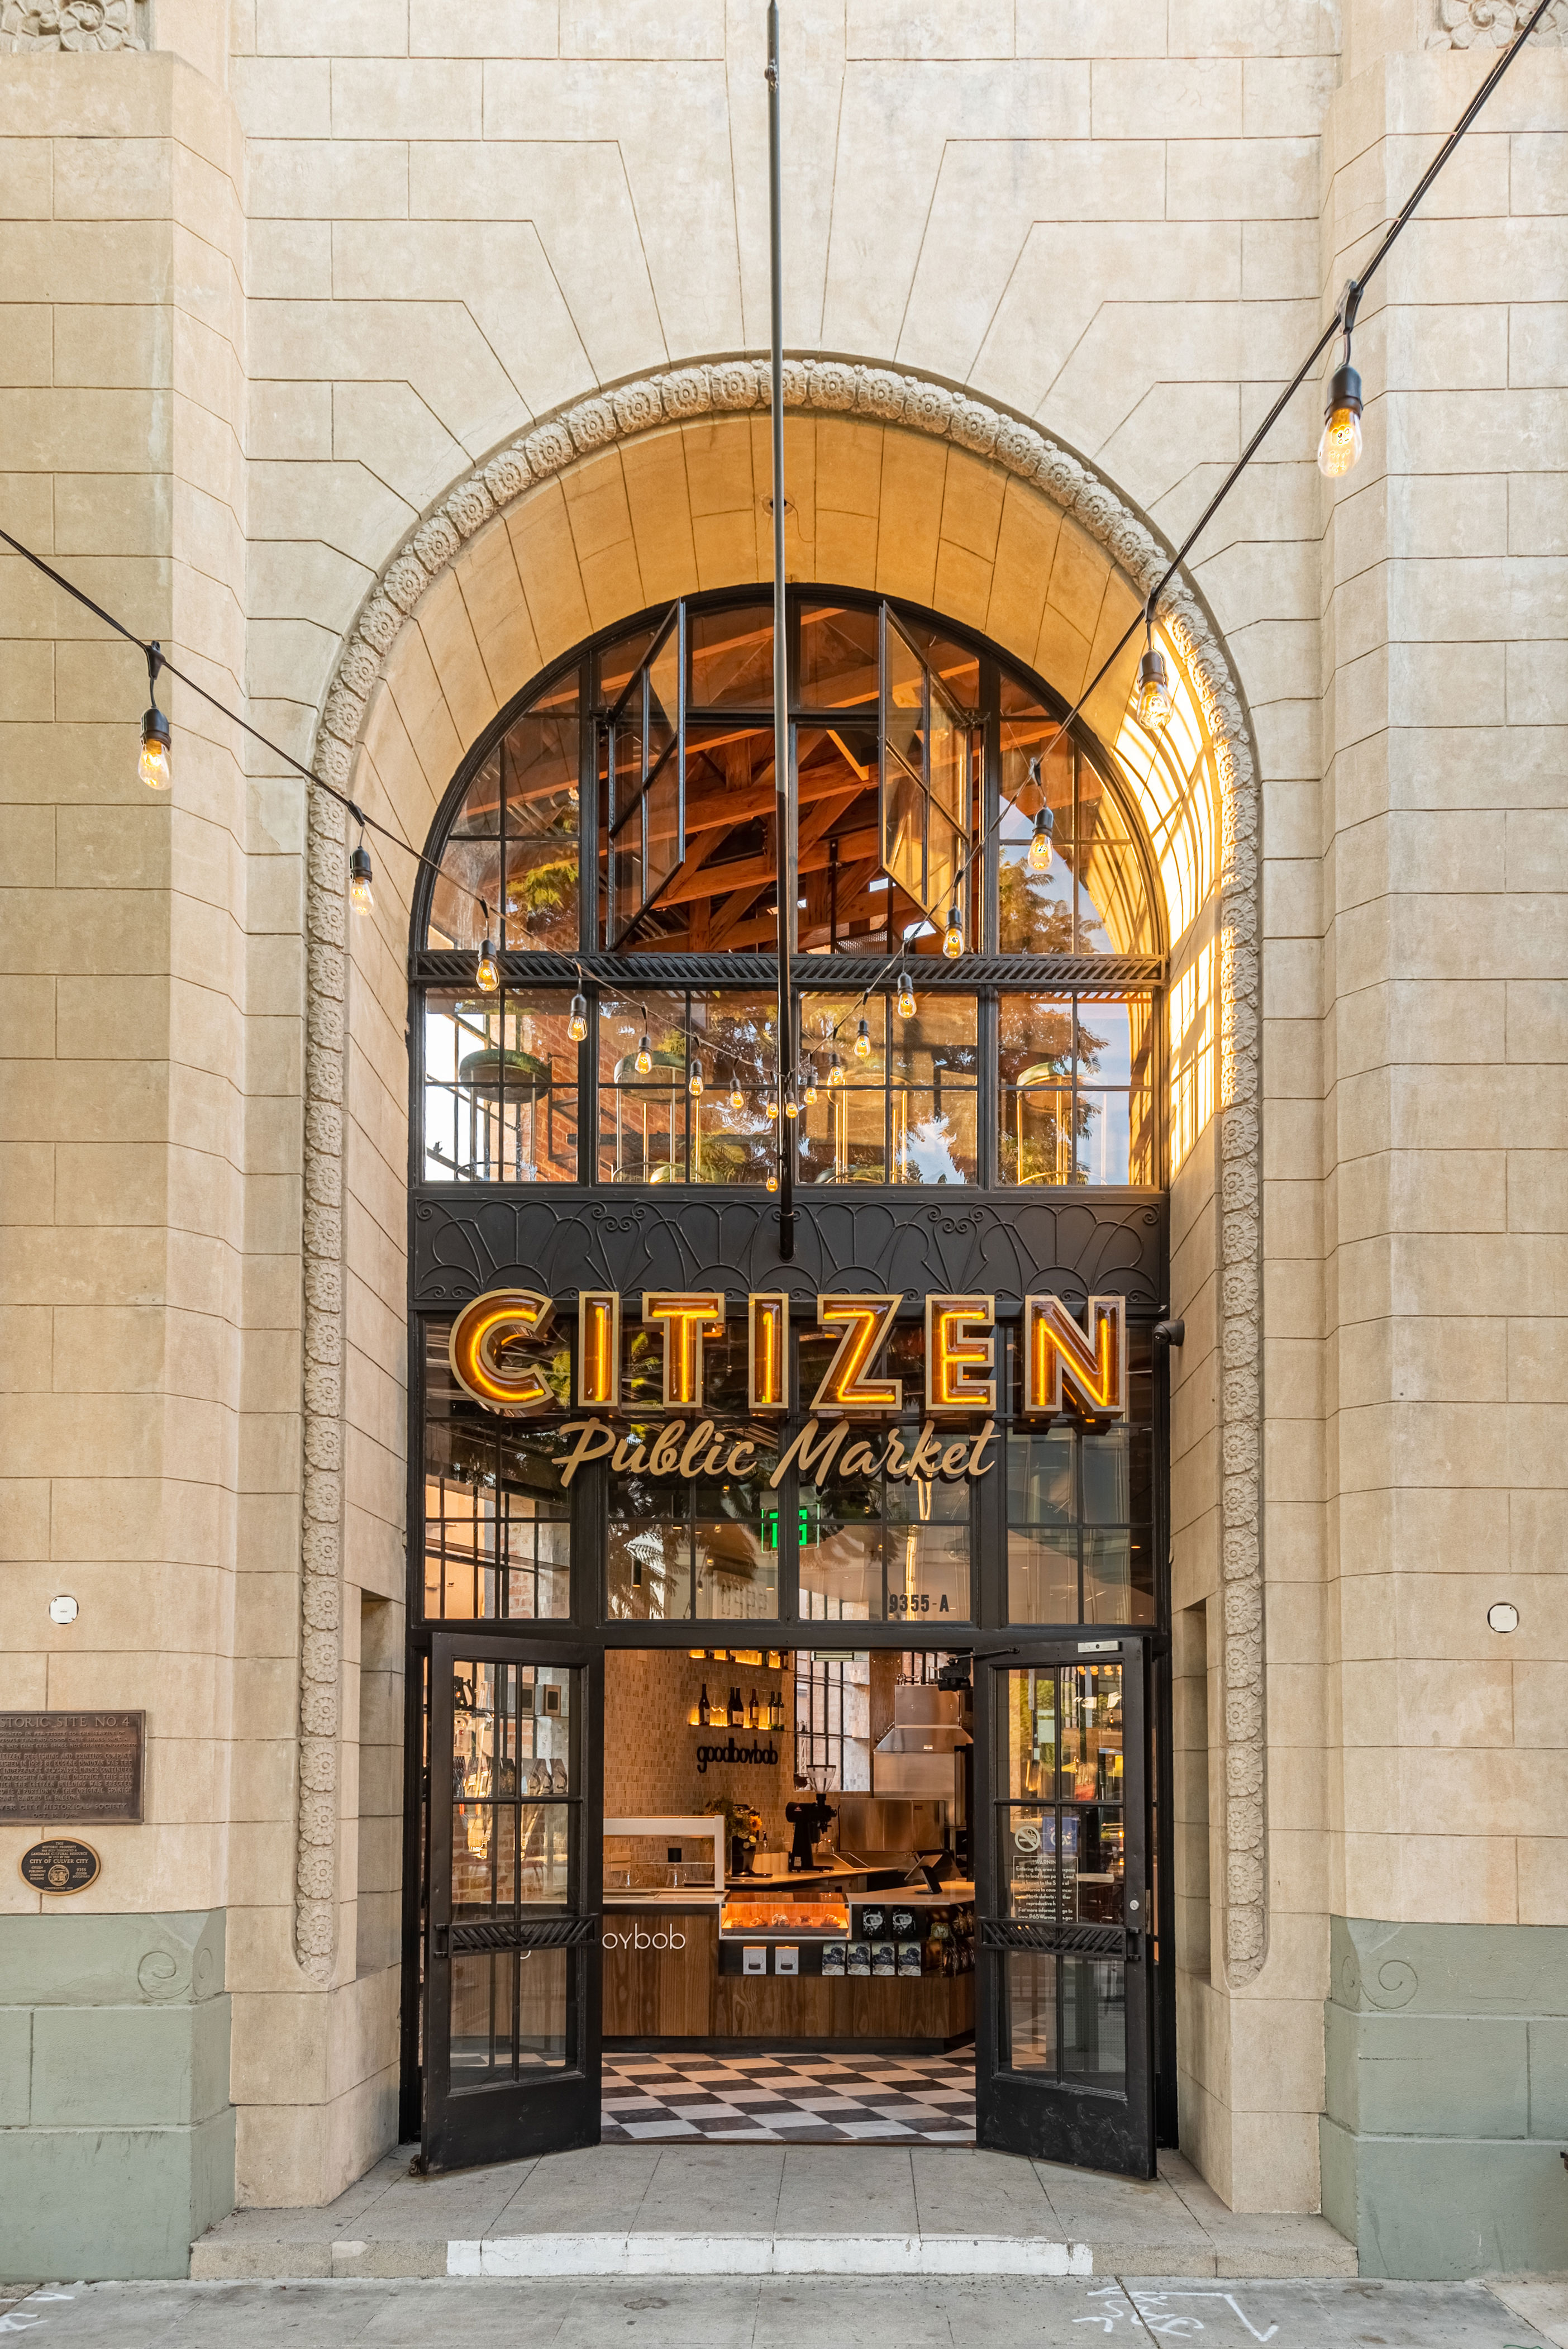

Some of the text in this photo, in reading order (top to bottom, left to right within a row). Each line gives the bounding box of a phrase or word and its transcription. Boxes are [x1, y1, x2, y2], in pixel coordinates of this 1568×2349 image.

[449, 1289, 1126, 1411] CITIZEN
[552, 1417, 1002, 1489] Public Market
[57, 1716, 88, 1727] SITE
[122, 1716, 130, 1727] 4
